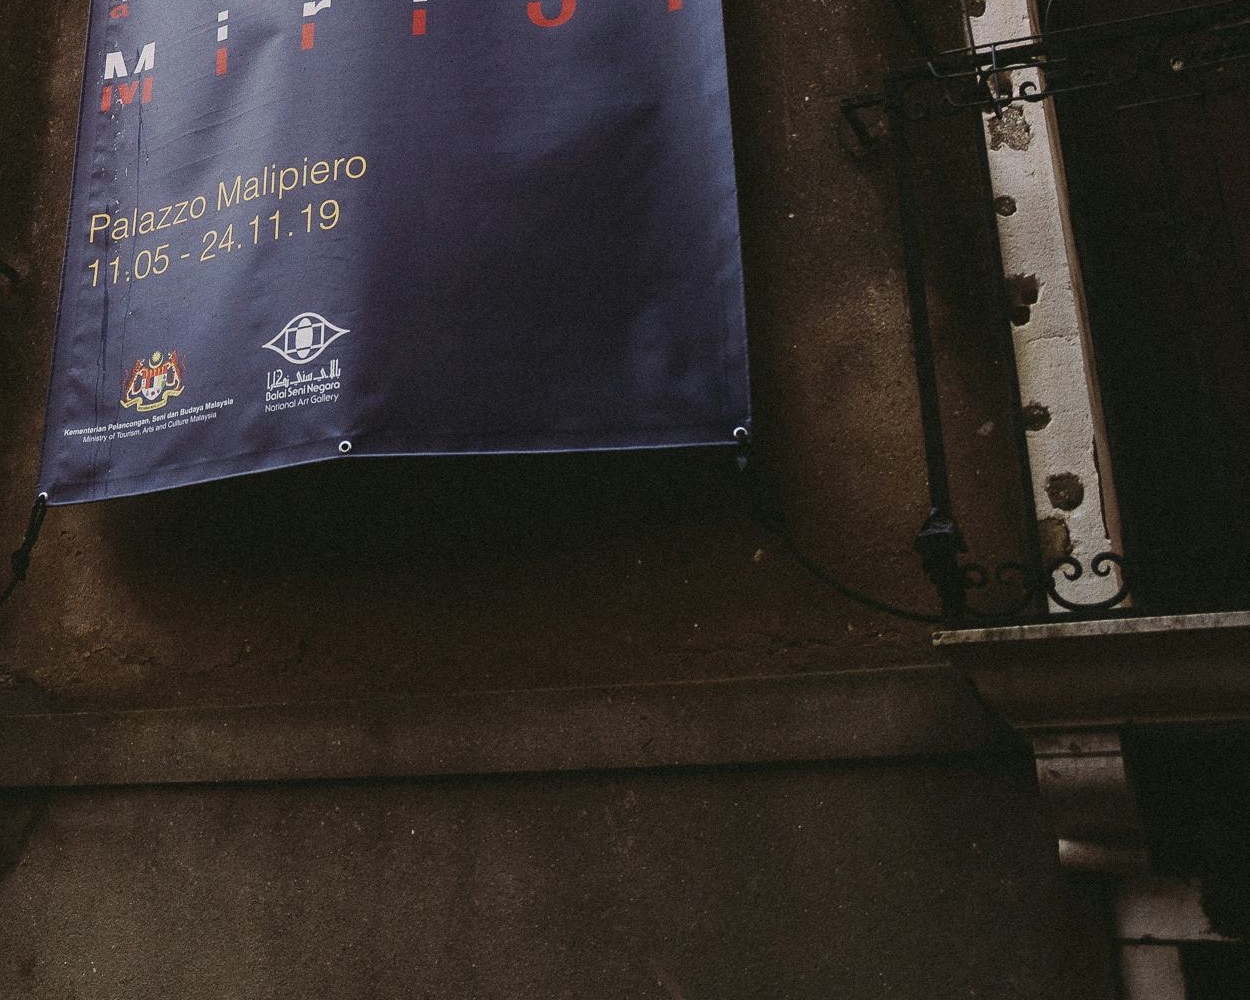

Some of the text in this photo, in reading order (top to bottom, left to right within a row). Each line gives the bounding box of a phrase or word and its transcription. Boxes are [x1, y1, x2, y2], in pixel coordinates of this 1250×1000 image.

[88, 155, 367, 243] Palazzo Malipiero
[199, 199, 341, 261] 24.11.19
[264, 393, 339, 413] National Art Gallery
[265, 381, 341, 402] Balai Seni Negara
[64, 398, 234, 436] Kementerian Pelancongan, Seni dan Budaya Malaysia
[82, 411, 217, 443] Ministry of Tourism, Arts and Culture Malaysia
